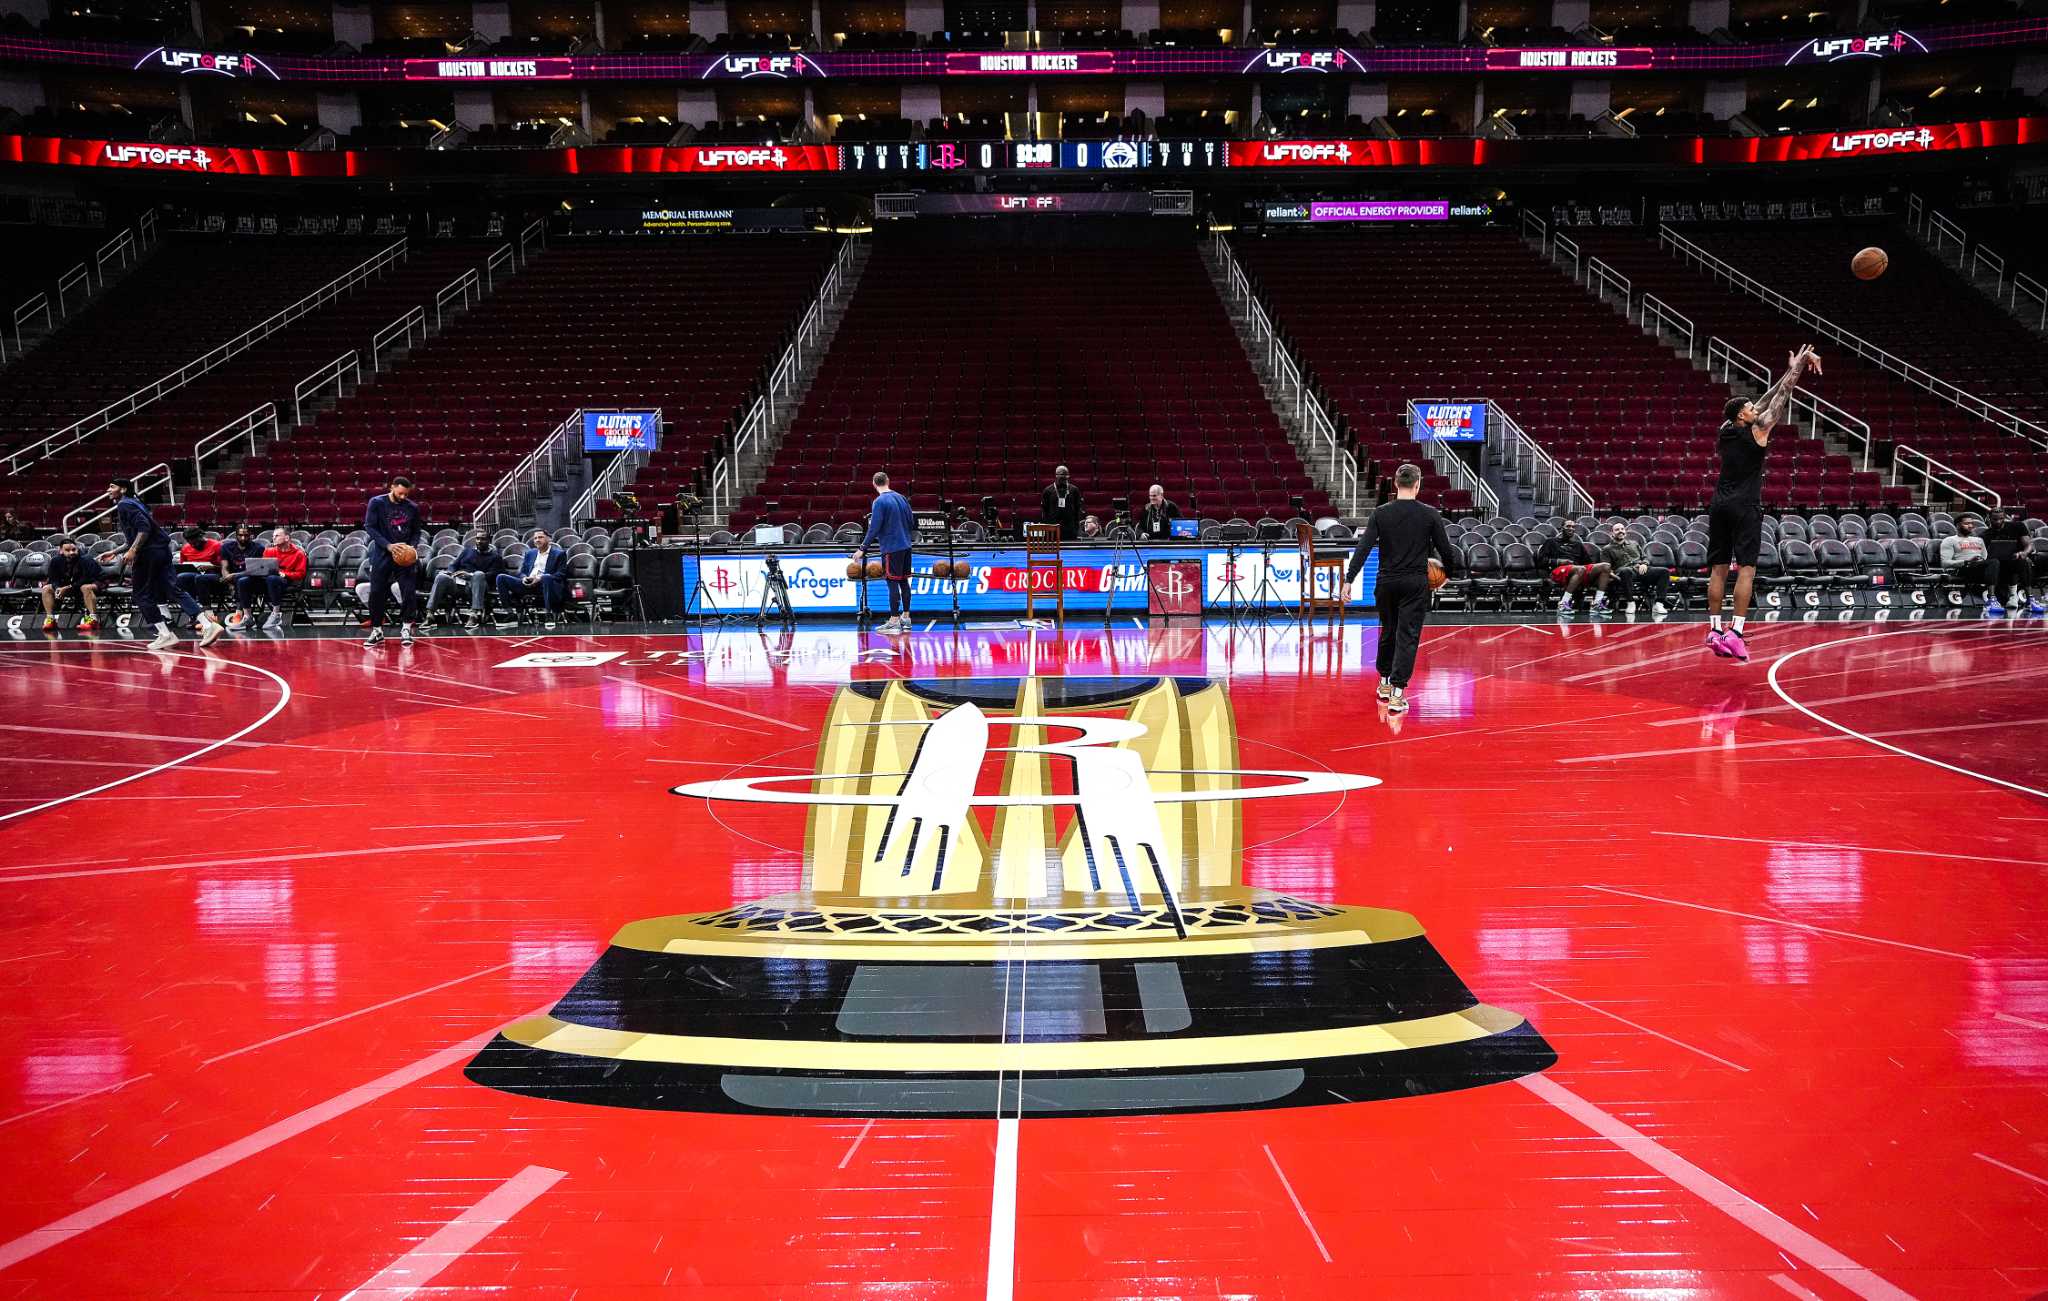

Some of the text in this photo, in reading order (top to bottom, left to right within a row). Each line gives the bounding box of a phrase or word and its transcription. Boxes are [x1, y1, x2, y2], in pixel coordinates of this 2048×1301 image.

[980, 55, 1077, 70] HOUSTON ROCKETS
[1520, 51, 1617, 66] HOUSTON ROCKETS
[438, 61, 536, 76] HOUSTON ROCKETS
[1832, 130, 1915, 151] LIFTOFF
[105, 144, 192, 165] LIFTOFF
[698, 150, 771, 166] LIFTOFF
[981, 144, 992, 168] 0
[1077, 143, 1088, 167] 0
[1263, 145, 1335, 160] LIFTOFF
[642, 210, 732, 220] MEMORIAL HERMANN
[1267, 207, 1298, 218] reliant
[1315, 205, 1444, 216] OFFICIAL ENERGY PROVIDER
[1450, 205, 1481, 215] reliant
[1427, 406, 1472, 419] CLUTCH'S
[597, 416, 642, 429] CLUTCH'S
[1005, 569, 1087, 590] GROCRY
[1099, 564, 1148, 592] GAM
